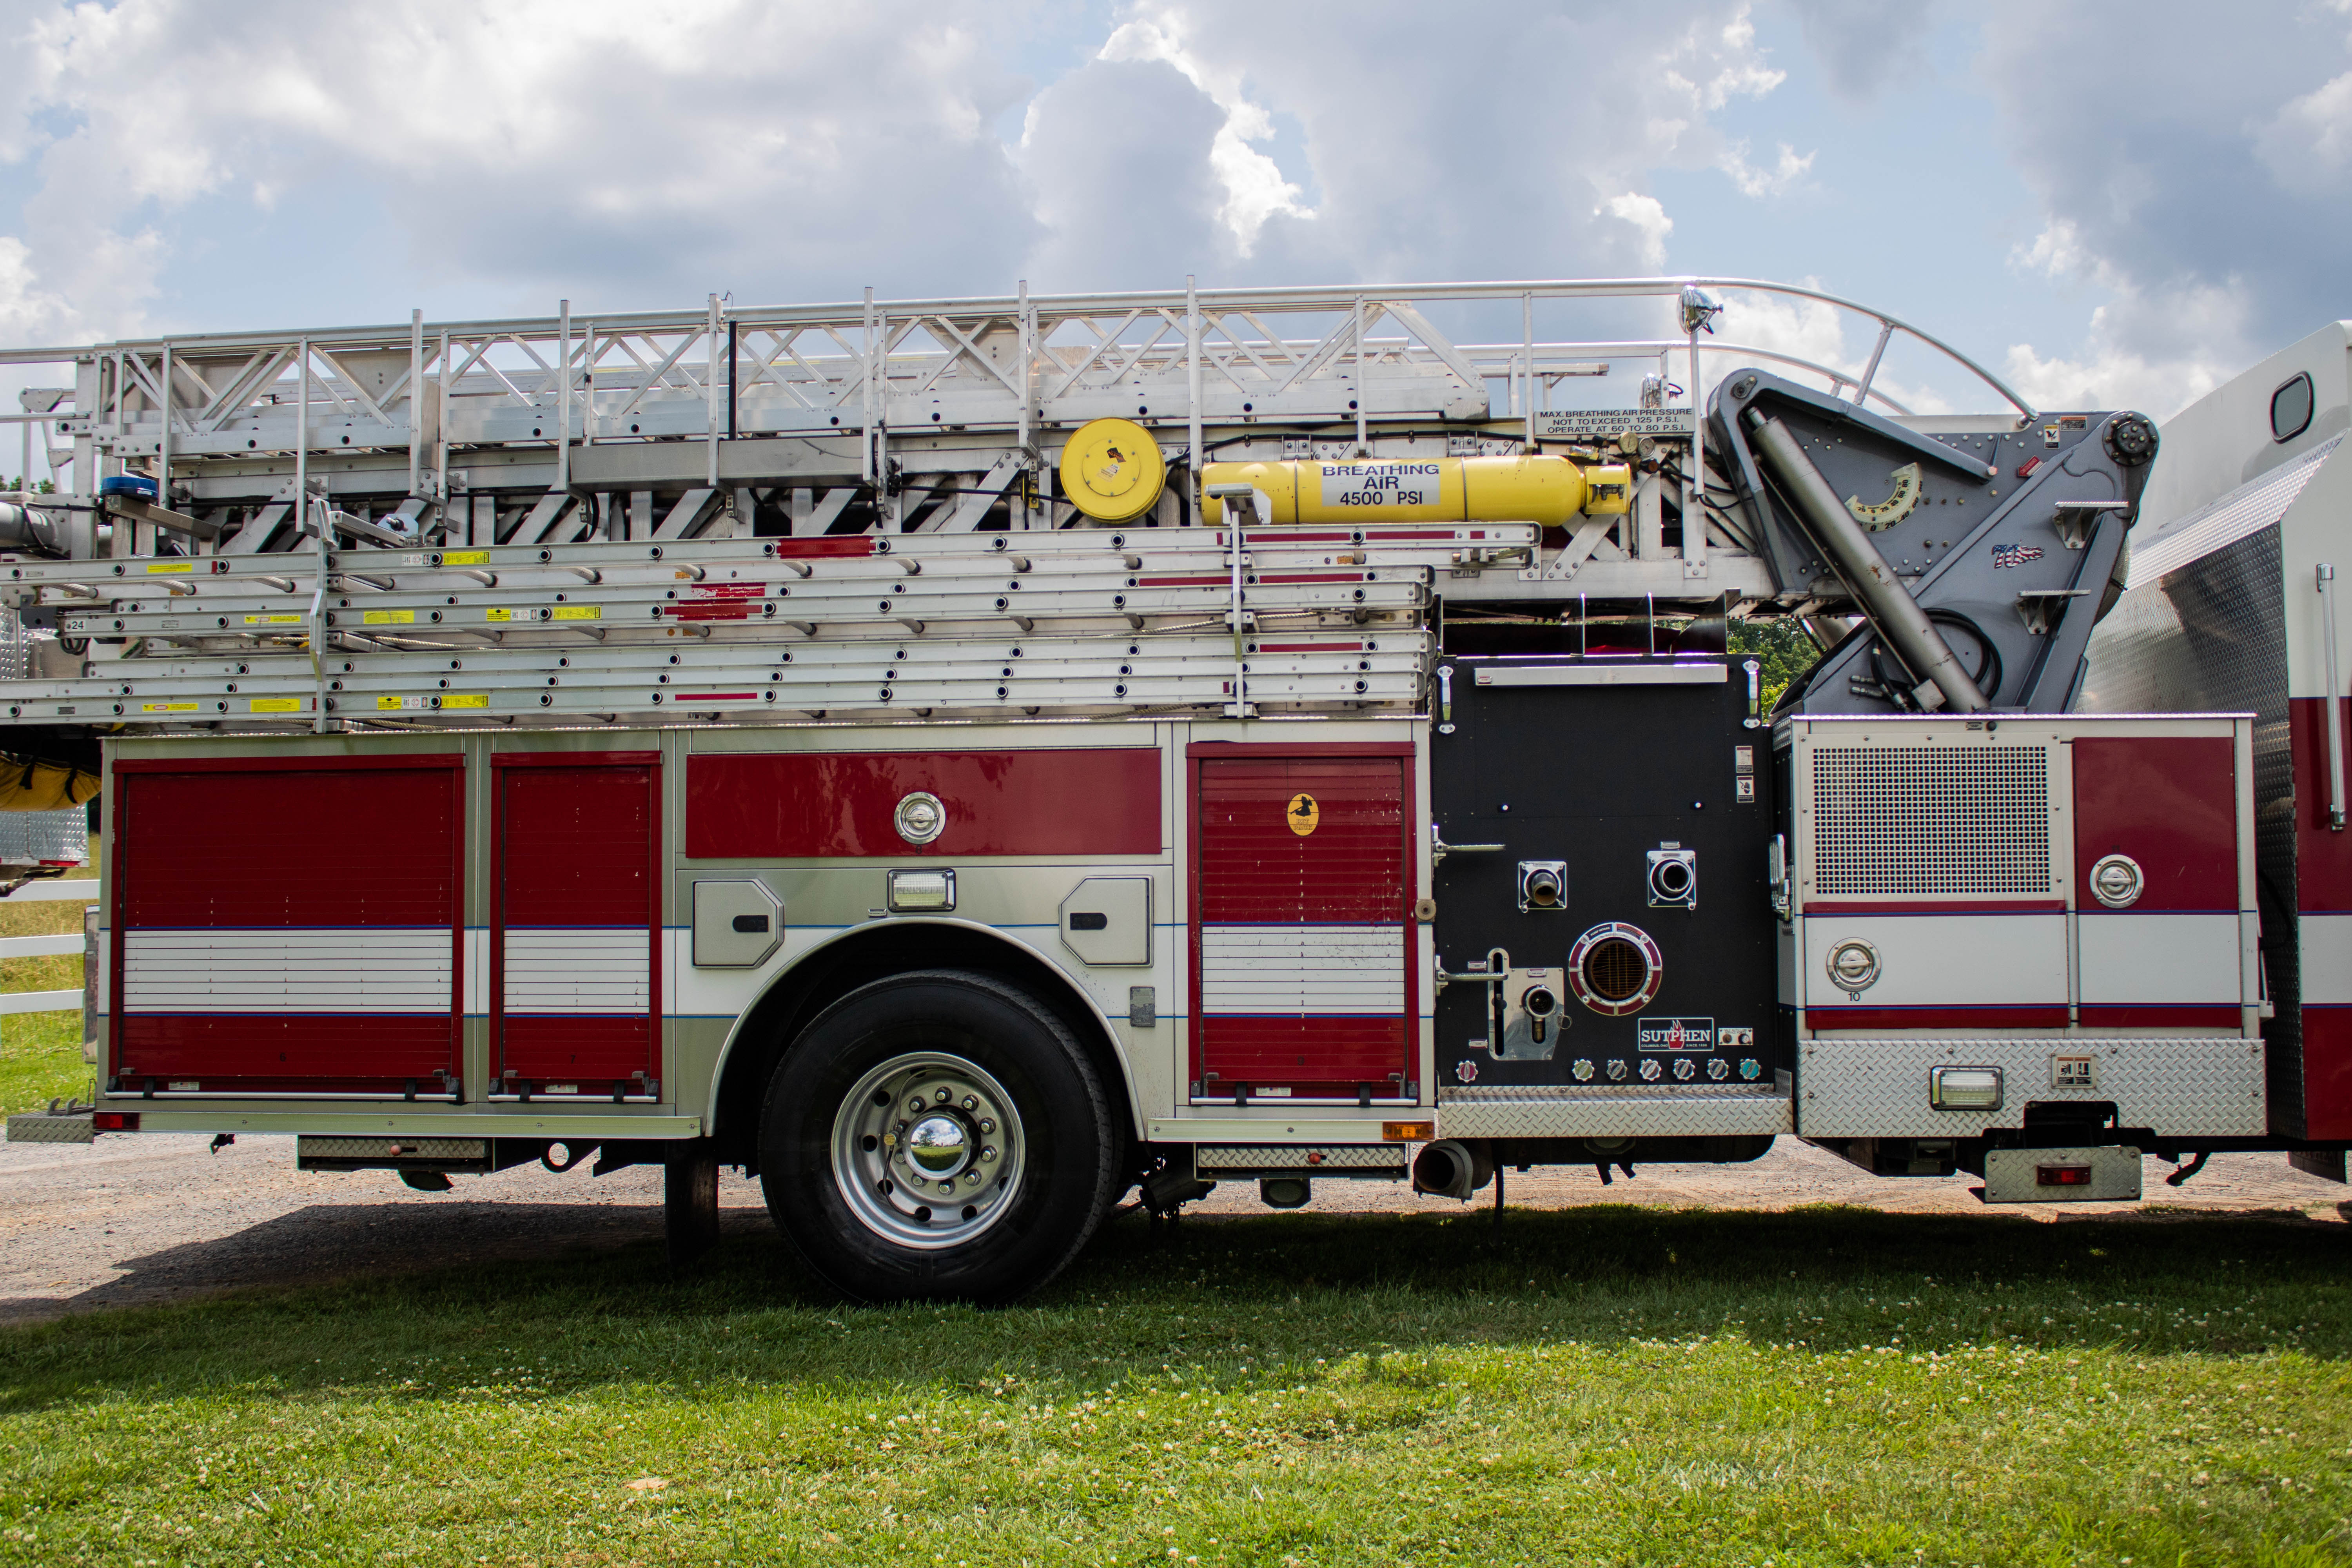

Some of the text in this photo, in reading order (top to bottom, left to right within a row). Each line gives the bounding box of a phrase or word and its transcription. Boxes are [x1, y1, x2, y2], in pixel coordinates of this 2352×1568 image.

[1323, 465, 1439, 476] BREATHING
[1363, 476, 1399, 489] AIR
[1340, 491, 1422, 505] 4500 PSI
[1885, 520, 1896, 529] 20
[72, 621, 84, 630] 24
[915, 845, 922, 854] 8
[1848, 992, 1860, 1002] 10
[1641, 1030, 1711, 1042] SUTPHEN
[280, 1052, 287, 1062] 6
[570, 1054, 576, 1064] 7
